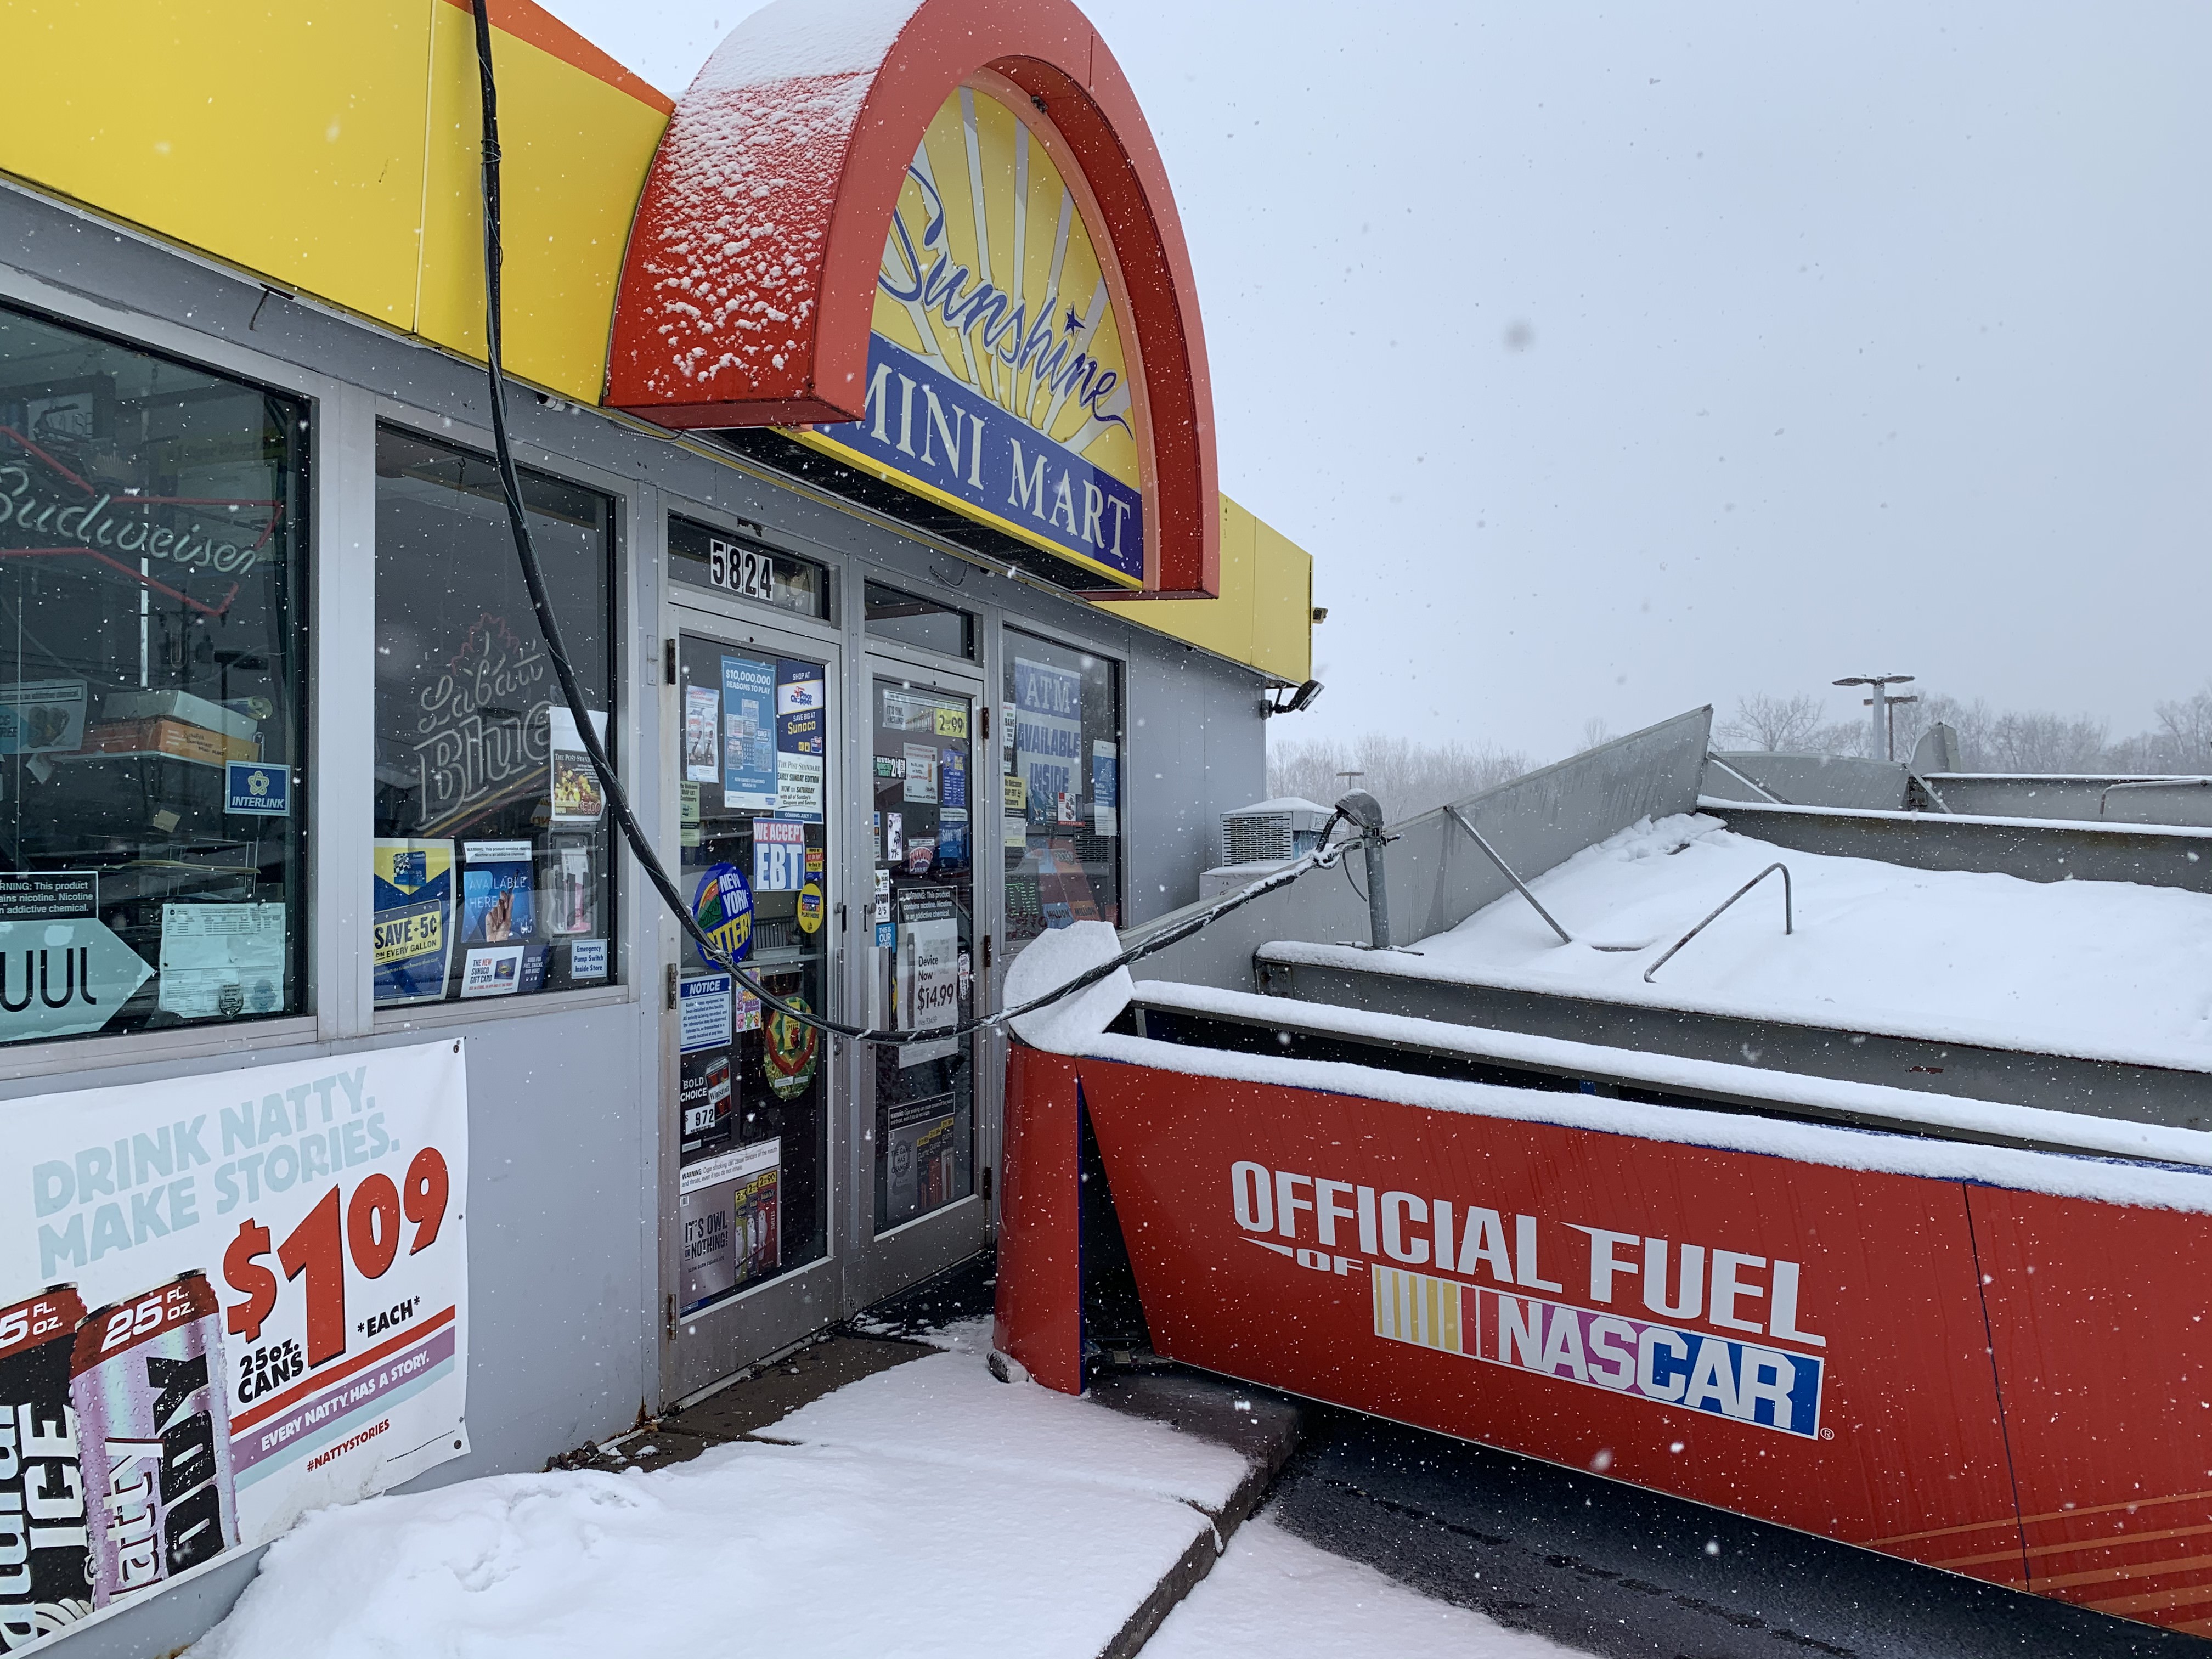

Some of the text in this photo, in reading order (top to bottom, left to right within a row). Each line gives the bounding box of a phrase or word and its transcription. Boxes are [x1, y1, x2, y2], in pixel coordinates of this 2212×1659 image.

[878, 165, 1134, 441] Sunshine
[855, 363, 1131, 558] MINI MART
[713, 542, 772, 599] 5824
[726, 669, 771, 685] $10,000,000
[793, 673, 804, 681] SHOP
[726, 680, 770, 695] REASONS TO PLAY
[799, 691, 812, 701] Price
[1025, 673, 1070, 714] ATM
[793, 714, 803, 722] SAVE
[788, 720, 816, 735] Sunoco
[1018, 723, 1081, 758] AVAILABLE
[777, 772, 820, 783] EARLY SUNDAY EDITION
[1030, 762, 1069, 793] INSIDE
[796, 786, 815, 794] SATURDAY
[232, 796, 285, 809] INTERLINK
[754, 822, 803, 842] WE ACCEPT
[941, 829, 953, 843] SAVE
[757, 843, 802, 889] EBT
[33, 882, 53, 890] This
[55, 881, 88, 891] product
[469, 876, 526, 890] AVAILABLE
[719, 873, 741, 893] NEW
[19, 894, 57, 902] nicotine.
[59, 893, 93, 901] Nicotine
[470, 896, 497, 909] HERE
[723, 890, 749, 917] YORK
[905, 891, 927, 901] WARNING:
[935, 890, 951, 900] product
[7, 904, 89, 914] addictive chemical.
[904, 903, 920, 911] contains
[915, 911, 933, 919] addictive
[933, 909, 950, 918] chemical.
[1047, 909, 1070, 920] MILLION
[374, 915, 437, 950] SAVE 5¢
[879, 933, 891, 943] OUR
[386, 947, 409, 958] EVERY
[410, 939, 437, 952] GALLON
[577, 946, 602, 954] Emergency
[482, 958, 493, 967] NEW
[918, 955, 939, 967] Device
[470, 975, 493, 984] GIFT CARD
[471, 967, 489, 975] SUNOCO
[918, 970, 934, 982] Now
[690, 980, 721, 995] NOTICE
[917, 983, 955, 1015] $14.99
[683, 1077, 704, 1090] BOLD
[680, 1087, 707, 1102] CHOICE
[710, 1085, 730, 1102] Winston
[33, 1066, 376, 1217] DRINK NATTY.
[681, 1169, 703, 1180] WARNING:
[703, 1166, 713, 1175] Cigar
[713, 1161, 727, 1171] smoking
[38, 1111, 400, 1279] MAKE STORIES.
[685, 1210, 728, 1243] IT'S OWL
[691, 1231, 729, 1259] NOTHING!
[1231, 1160, 1826, 1347] OFFICIAL FUEL
[1296, 1248, 1364, 1277] OF
[33, 1301, 57, 1318] FL.
[167, 1301, 195, 1321] OZ.
[32, 1316, 63, 1335] OZ.
[100, 1286, 190, 1353] 25 FL.
[239, 1338, 300, 1379] 25oz.
[1498, 1294, 1796, 1430] NASCAR
[238, 1349, 304, 1404] CANS
[261, 1350, 430, 1452] EVERY NATTY HAS A STORY.
[306, 1419, 390, 1473] #NATTYSTORIES
[18, 1402, 88, 1551] ICE
